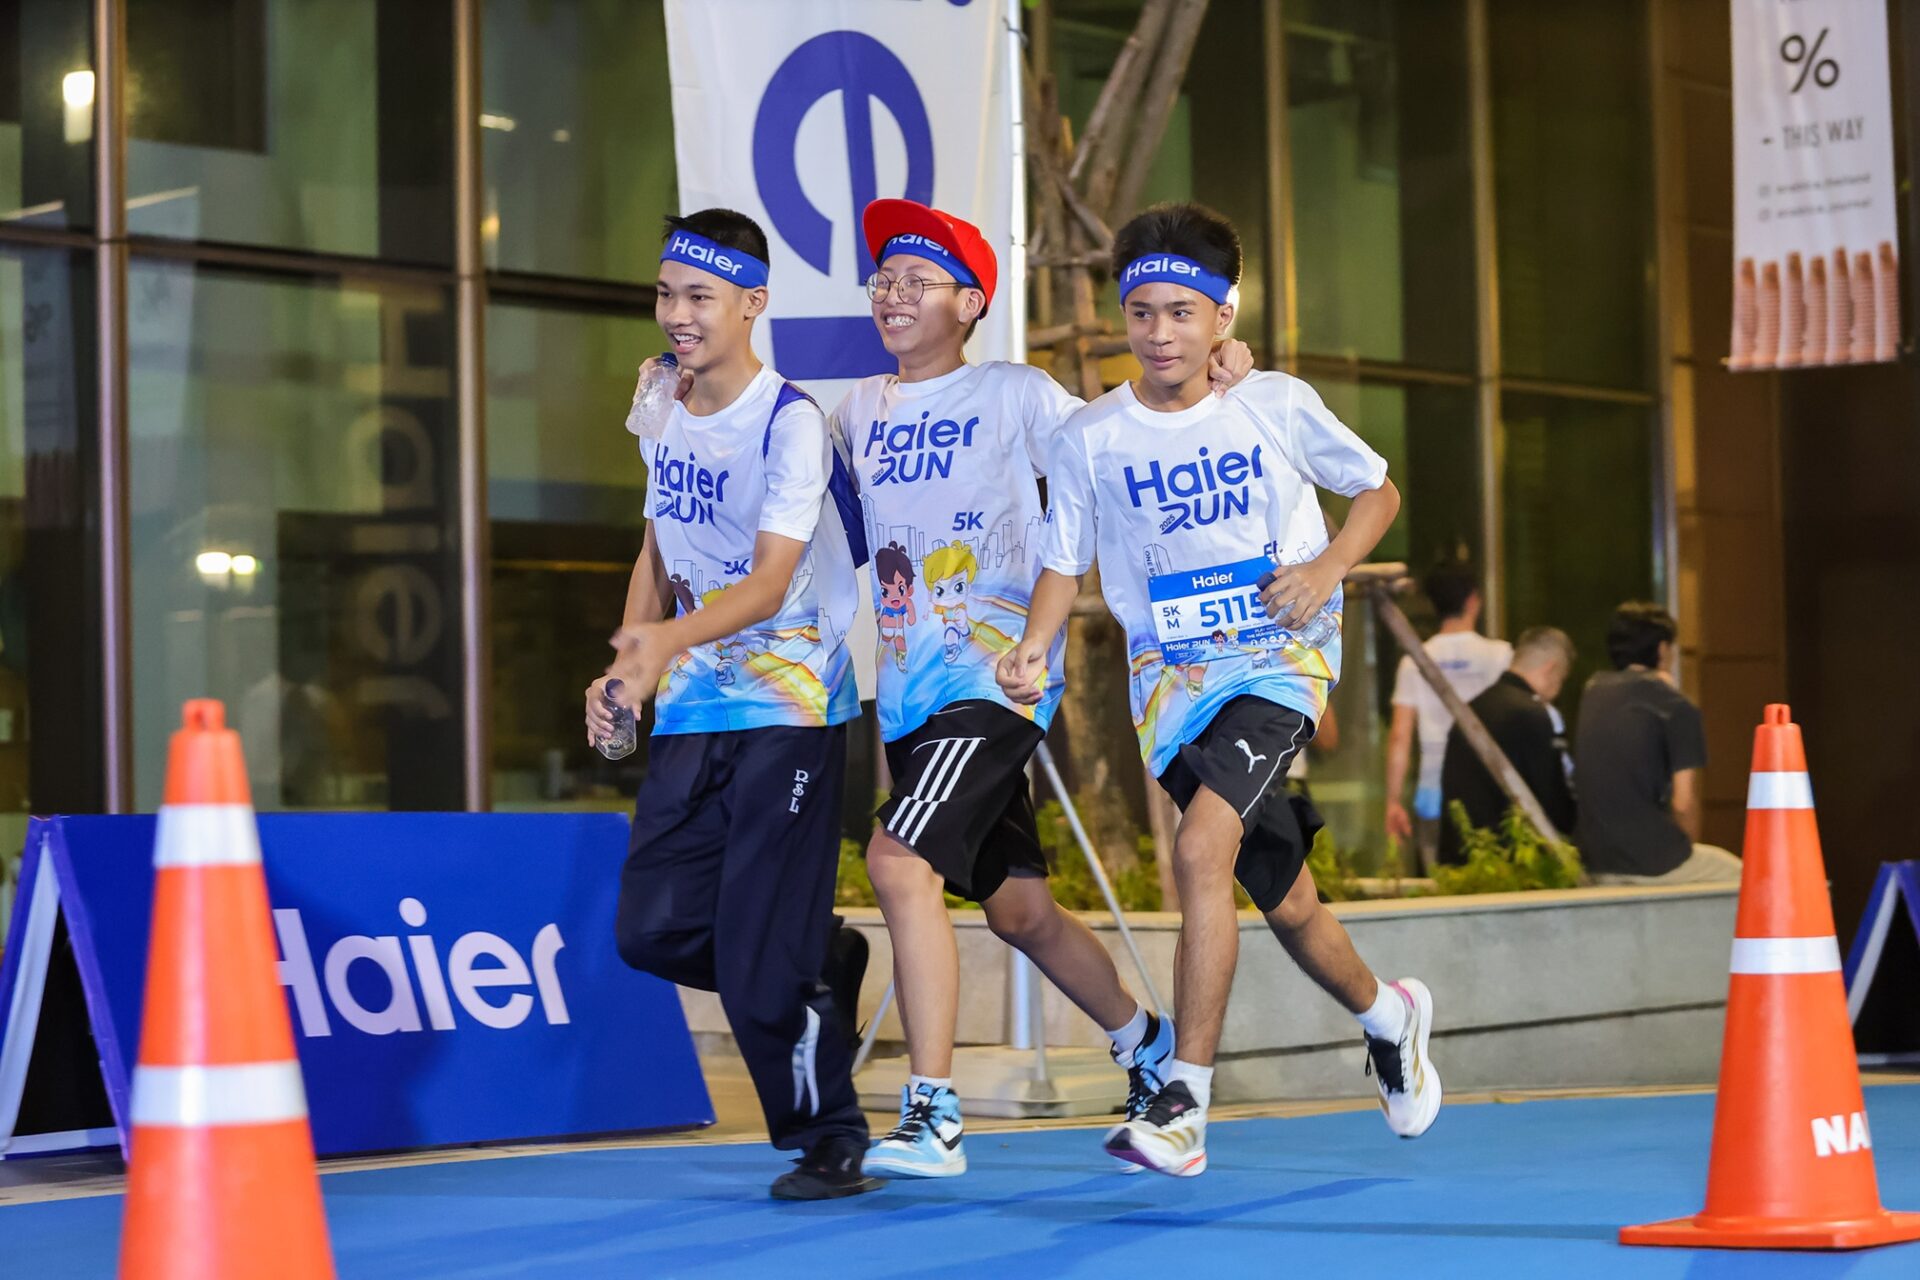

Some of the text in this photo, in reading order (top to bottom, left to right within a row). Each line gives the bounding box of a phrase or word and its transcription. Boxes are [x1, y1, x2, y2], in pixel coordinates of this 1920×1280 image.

[1783, 117, 1864, 150] THIS WAY
[671, 236, 743, 275] Haier
[1126, 257, 1201, 283] Haier
[863, 410, 980, 458] Haier
[654, 442, 730, 503] Haier
[871, 450, 954, 487] RUN
[1123, 443, 1263, 508] Haier
[951, 511, 985, 532] 5K
[1158, 485, 1250, 536] 2025 RUN
[1191, 571, 1234, 590] Haier
[1162, 605, 1182, 618] 5K
[1166, 618, 1181, 630] M
[1199, 591, 1267, 628] 5115
[1165, 640, 1191, 653] Haier
[1810, 1110, 1871, 1158] NA
